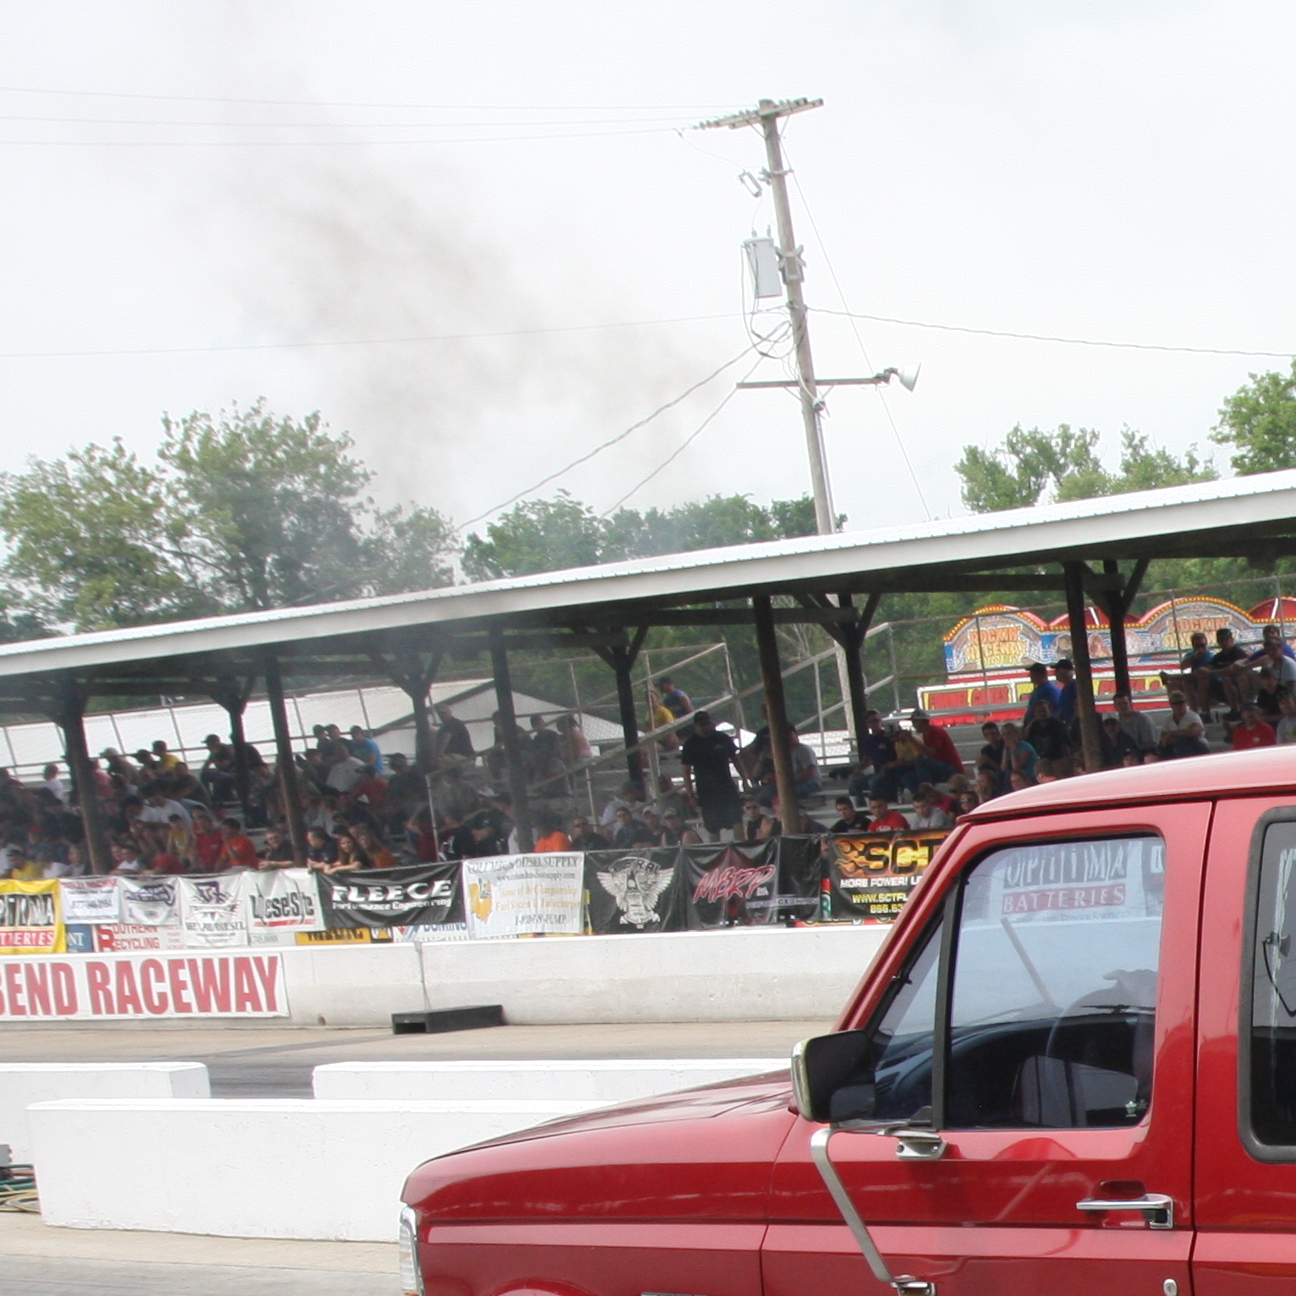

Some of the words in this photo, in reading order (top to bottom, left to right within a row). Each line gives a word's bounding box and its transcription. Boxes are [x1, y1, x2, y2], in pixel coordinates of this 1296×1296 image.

[543, 856, 578, 867] SUPPLY
[865, 838, 942, 874] SCT
[332, 879, 452, 902] FLEECE
[840, 878, 868, 888] MORE
[870, 877, 908, 888] POWER!
[332, 901, 391, 910] Performance
[392, 898, 451, 911] Engineering
[1003, 886, 1125, 913] BATTERIES
[100, 936, 160, 950] RECYCLING
[0, 963, 79, 1016] END
[86, 956, 279, 1016] RACEWAY
